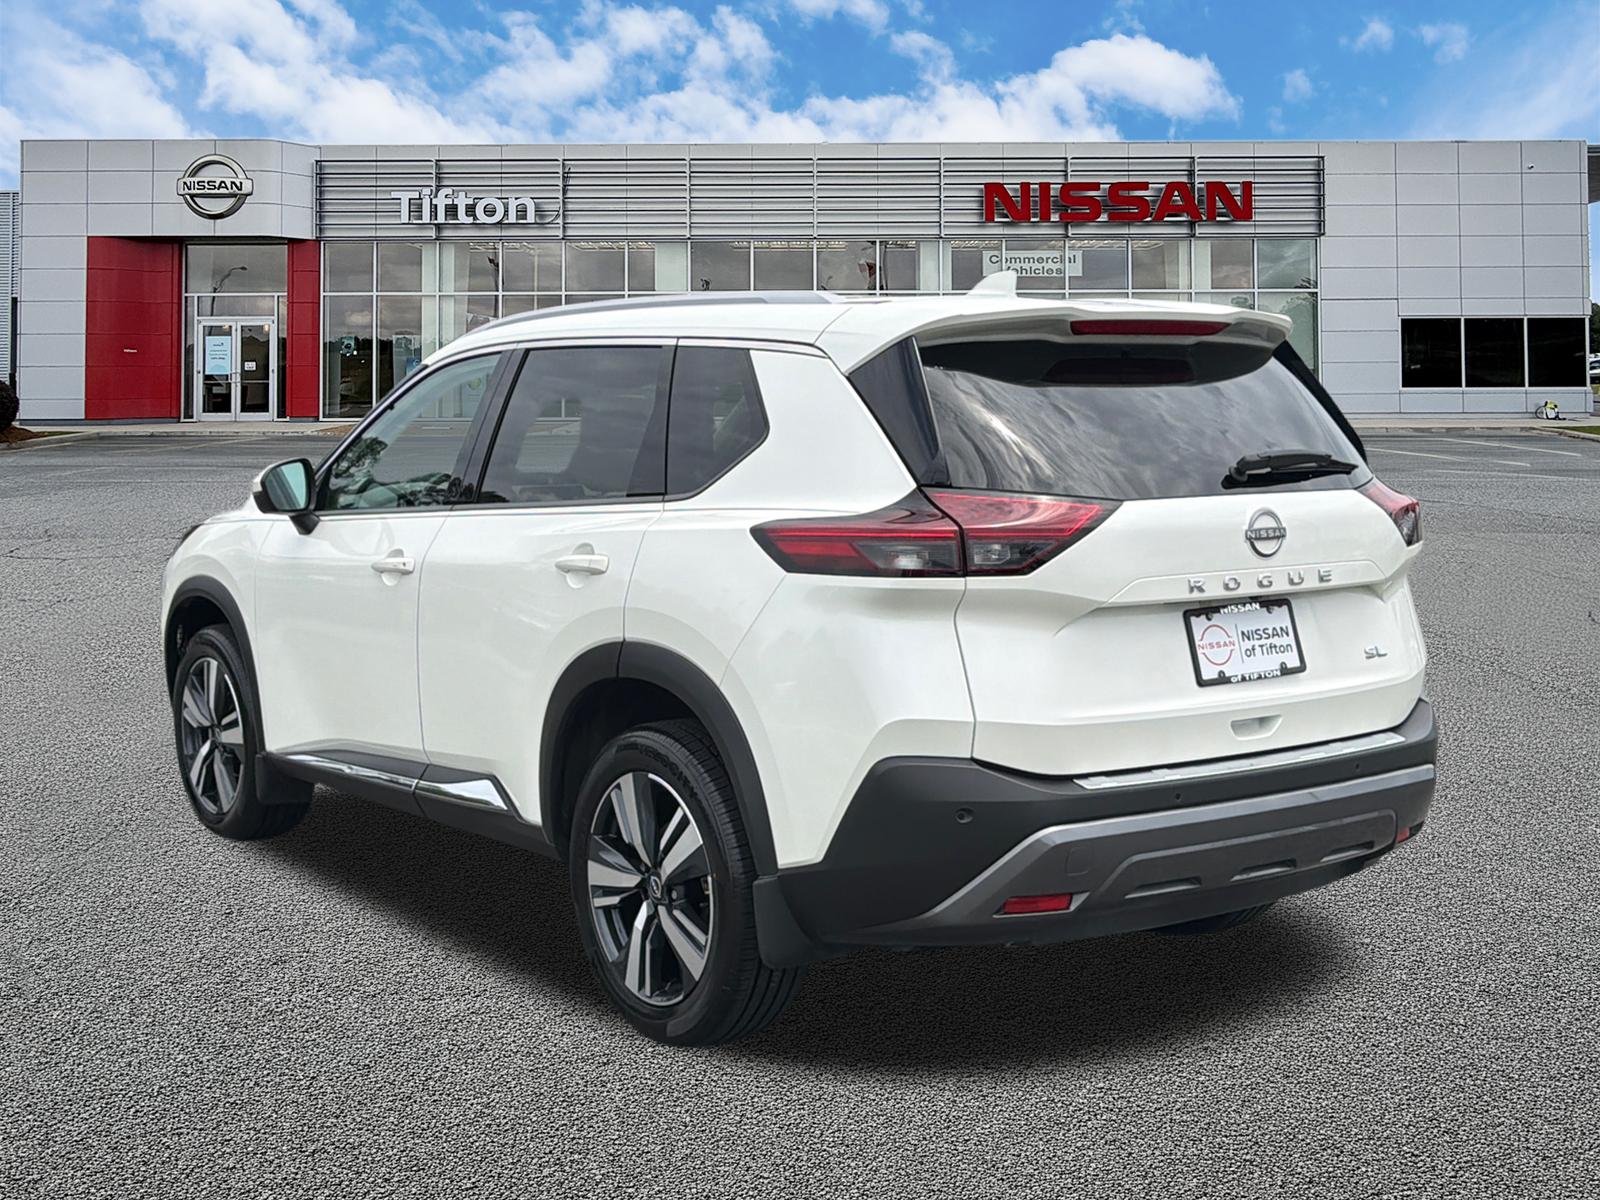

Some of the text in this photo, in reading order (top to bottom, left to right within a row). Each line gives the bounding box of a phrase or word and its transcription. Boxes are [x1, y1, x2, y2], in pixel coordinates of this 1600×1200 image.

[182, 180, 244, 192] NISSAN
[391, 188, 536, 224] Tifton
[983, 180, 1254, 223] NISSAN
[1247, 529, 1286, 539] NISSAN
[1188, 569, 1333, 594] ROGUE
[1220, 602, 1261, 615] NISSAN
[1241, 625, 1290, 643] NISSAN
[1198, 640, 1236, 651] NISSAN
[1244, 642, 1294, 659] of Tifton
[1364, 645, 1389, 660] SL
[1230, 669, 1282, 683] of TIFTON
